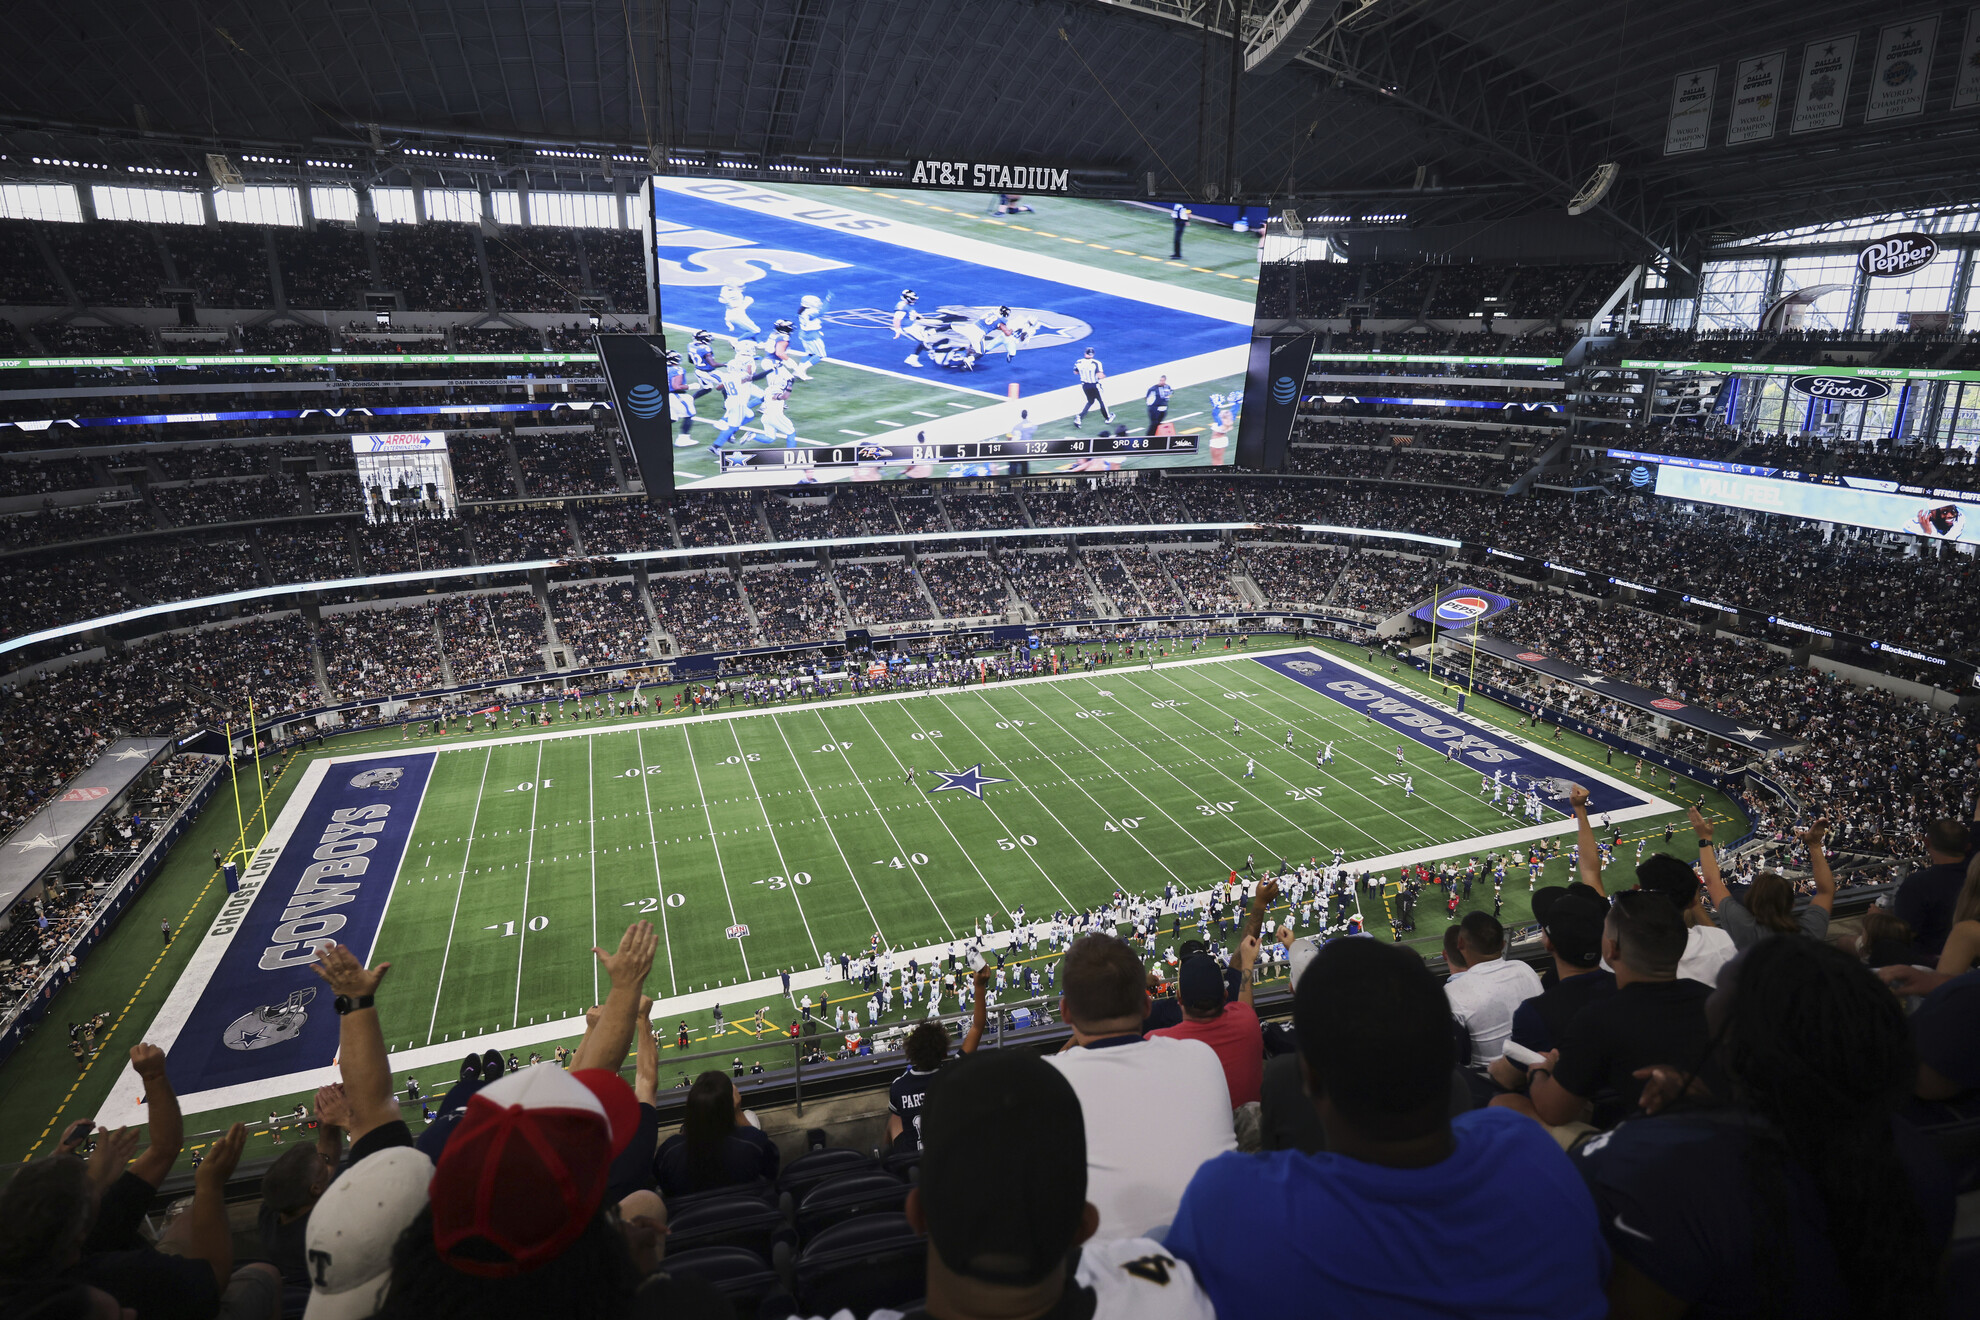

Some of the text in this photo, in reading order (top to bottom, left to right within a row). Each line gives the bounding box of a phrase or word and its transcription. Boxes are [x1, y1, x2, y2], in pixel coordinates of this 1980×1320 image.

[1886, 46, 1923, 61] COWBOYS
[1891, 39, 1922, 53] DALLAS
[1810, 63, 1843, 76] COWBOYS
[1814, 56, 1841, 68] DALLAS
[1743, 79, 1773, 91] COWBOYS
[1747, 72, 1771, 83] DALLAS
[1679, 92, 1706, 103] COWBOYS
[1683, 87, 1705, 96] DALLAS
[1882, 88, 1913, 99] WORLD
[1806, 102, 1834, 112] WORLD
[1871, 95, 1921, 110] CHAMPIONS
[1796, 109, 1841, 122] CHAMPIONS
[1885, 106, 1904, 116] 1993
[1739, 115, 1765, 125] WORLD
[1808, 119, 1825, 128] 1992
[1676, 127, 1699, 135] WORLD
[1731, 122, 1772, 134] CHAMPIONS
[1669, 133, 1705, 144] CHAMPIONS
[912, 160, 1069, 191] AT&T STADIUM
[1886, 239, 1914, 258] Dr
[1861, 243, 1932, 273] Pepper
[1810, 377, 1868, 398] Ford
[385, 434, 422, 445] ARROW
[1112, 439, 1149, 449] 3RD & 8
[912, 445, 966, 460] BAL 5
[988, 442, 1084, 454] 1ST 1:32 :40
[783, 449, 842, 465] DAL 0
[1782, 471, 1799, 479] 1:32
[1744, 484, 1784, 506] FEEL
[1933, 489, 1960, 499] OFFICIAL
[1550, 563, 1586, 577] Blockchain.com
[1614, 578, 1657, 594] Blockchain.com
[1690, 596, 1738, 614] Blockchain.com
[1777, 618, 1832, 637] Blockchain.com
[1881, 643, 1946, 666] Blockchain.com
[1326, 680, 1522, 763] COWBOYS
[1406, 690, 1448, 709] TAKES
[1482, 724, 1504, 734] OF
[1506, 735, 1528, 745] US
[910, 730, 944, 742] 50
[1285, 786, 1319, 801] 20
[1196, 801, 1230, 817] 30
[1103, 817, 1140, 834] 40
[996, 833, 1038, 852] 50
[887, 852, 930, 871] 40
[258, 804, 392, 970] COWBOYS
[767, 871, 812, 892] 30
[211, 881, 260, 937] CHOOSE
[251, 847, 280, 880] LOVE
[638, 893, 687, 914] 20
[500, 915, 549, 939] 10
[309, 1248, 332, 1287] T
